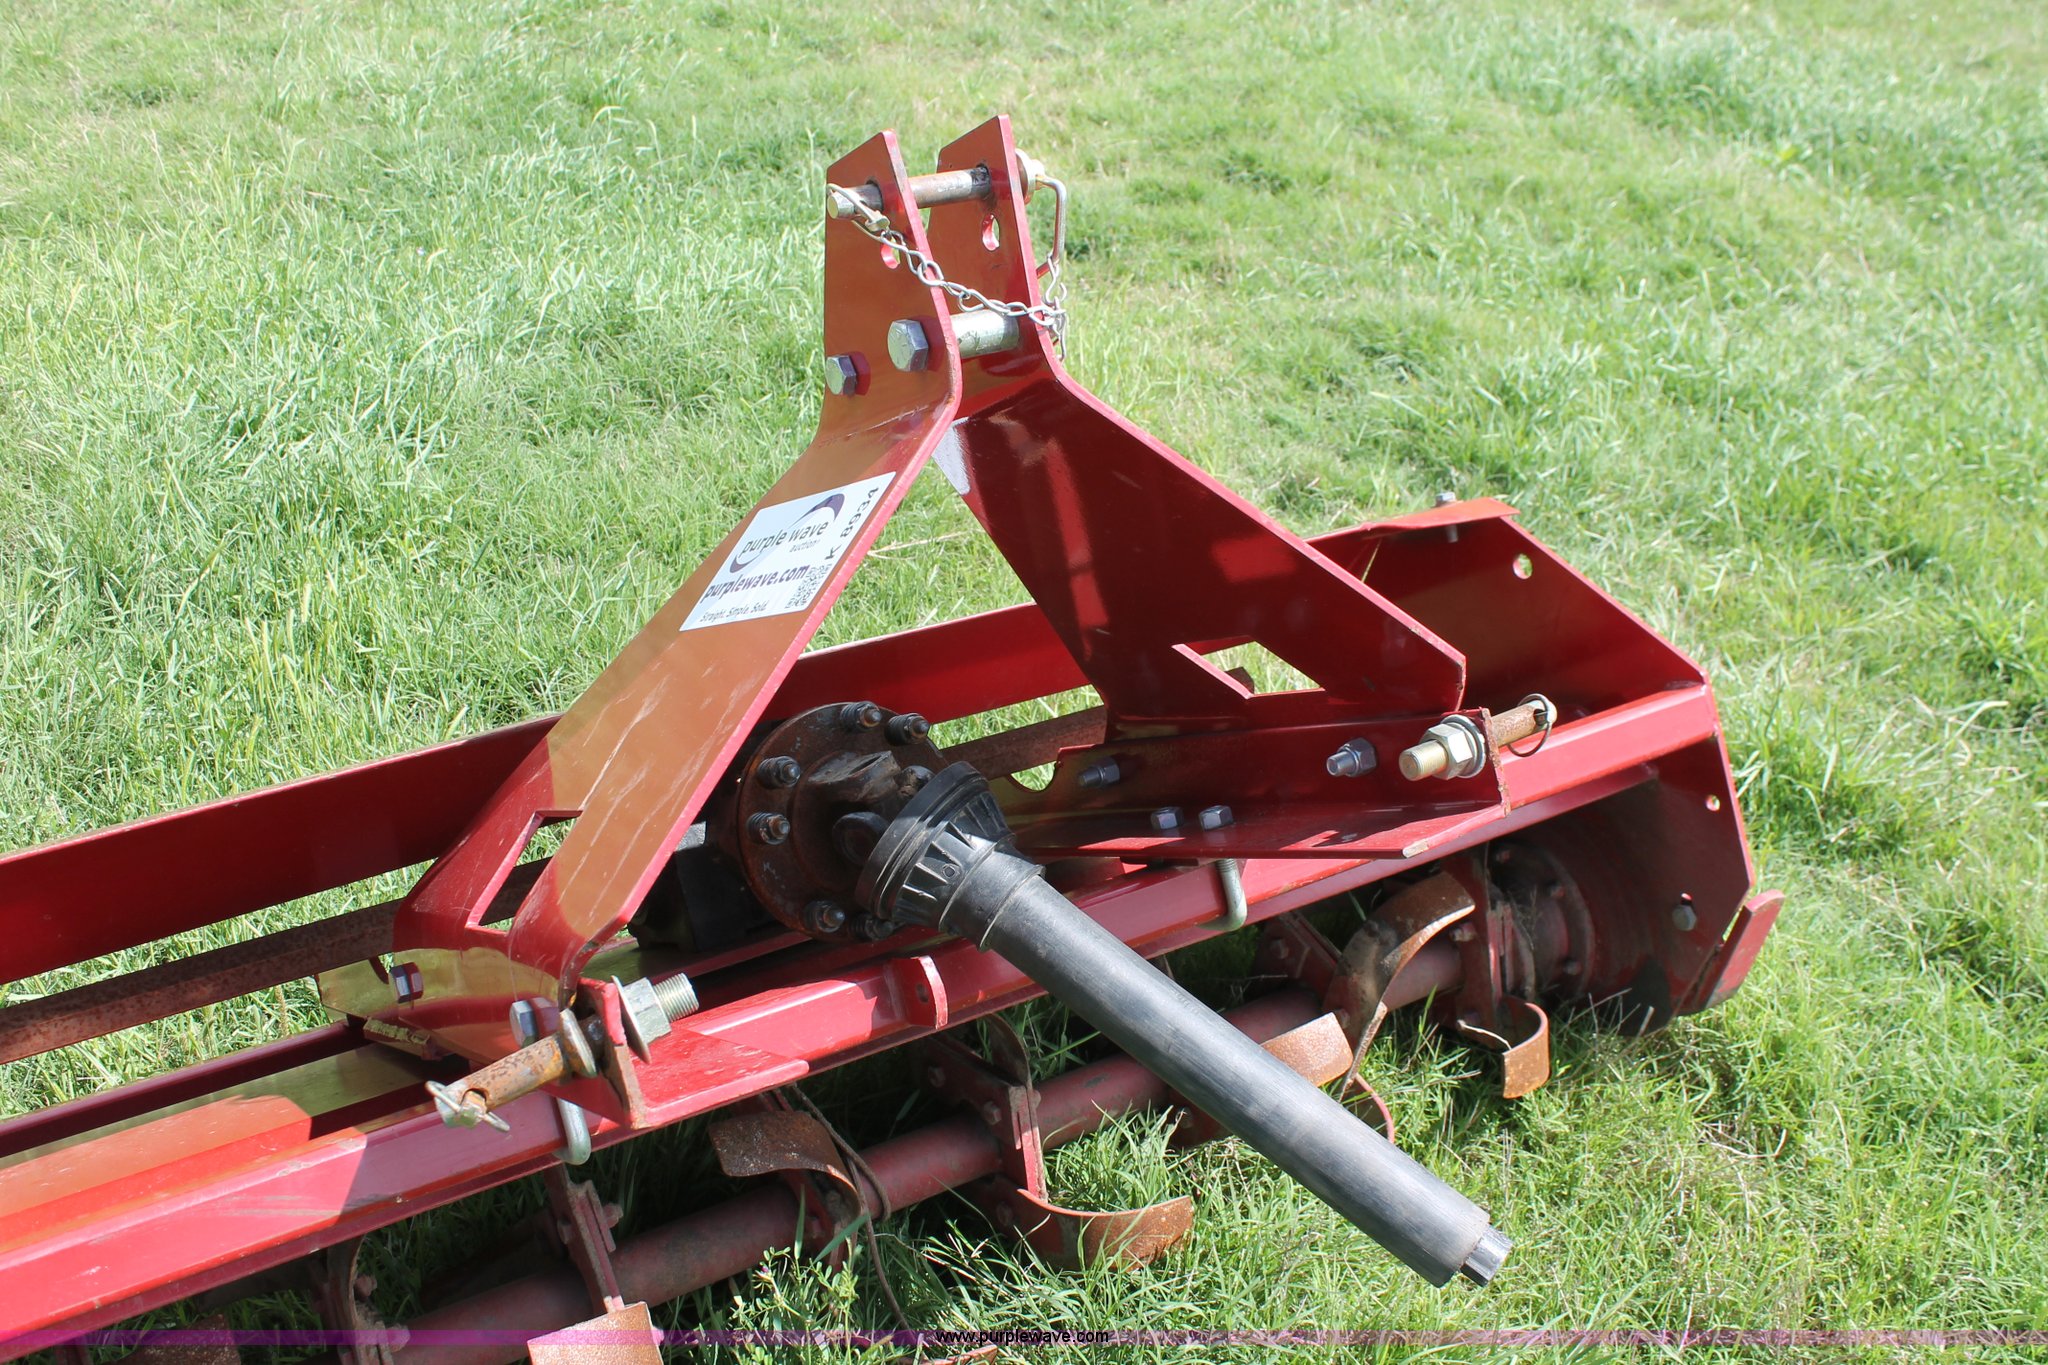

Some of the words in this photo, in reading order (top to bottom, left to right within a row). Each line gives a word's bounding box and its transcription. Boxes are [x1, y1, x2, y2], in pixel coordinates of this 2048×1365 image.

[738, 528, 787, 558] purple
[788, 521, 828, 543] wave
[825, 545, 842, 560] K
[701, 564, 810, 604] purplewave.com
